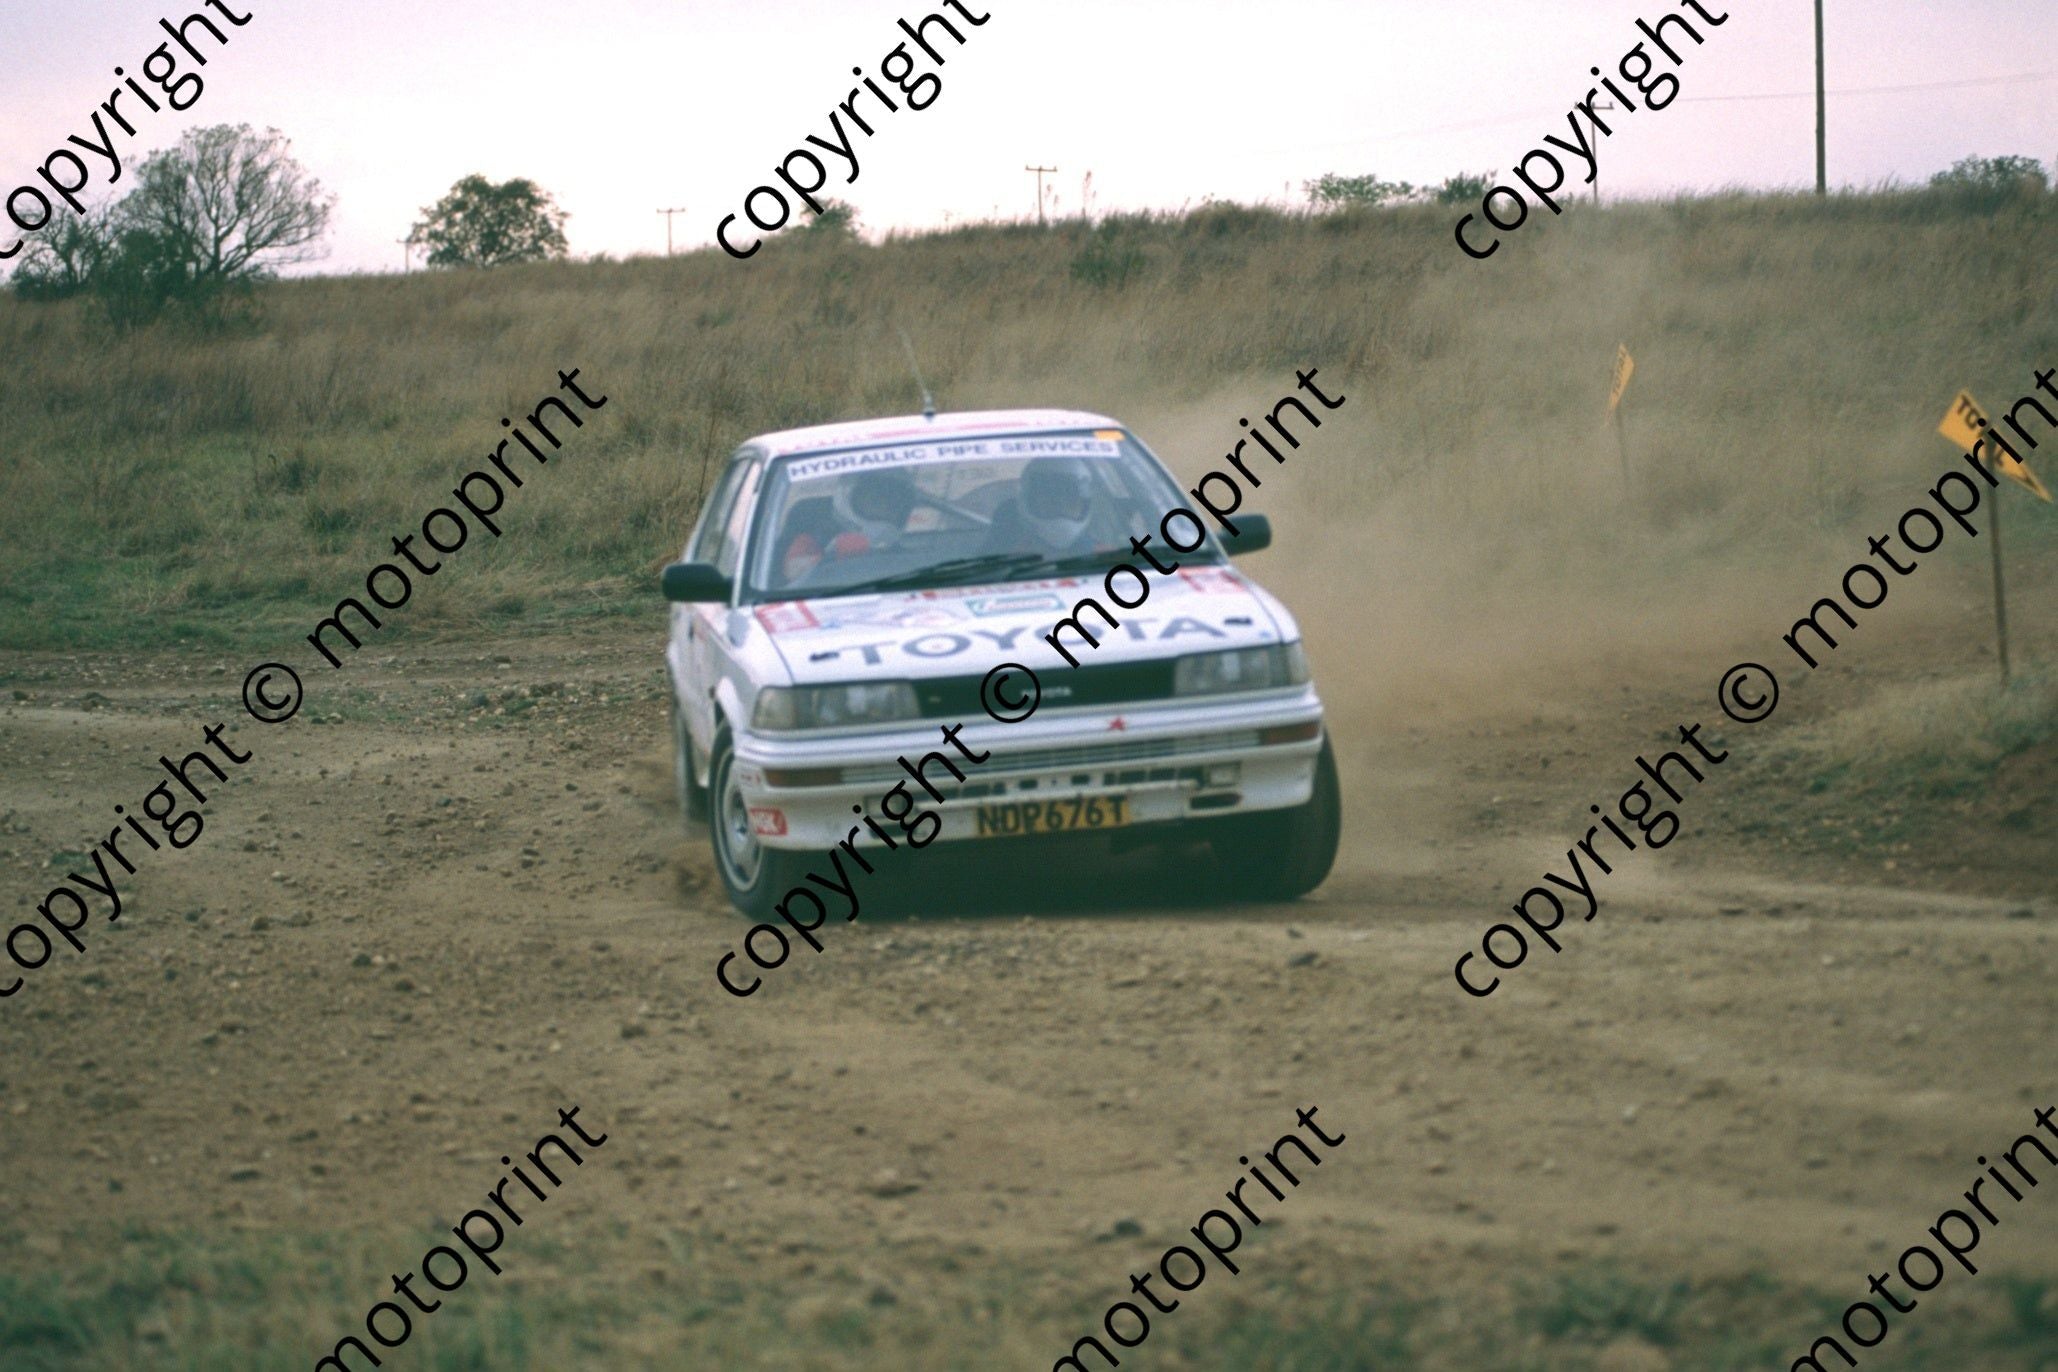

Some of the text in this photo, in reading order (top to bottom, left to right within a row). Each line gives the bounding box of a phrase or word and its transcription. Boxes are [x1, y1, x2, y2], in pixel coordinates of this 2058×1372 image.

[790, 438, 1115, 477] HYDRAULIC PIPE SERVICES
[838, 617, 1227, 666] TOYOTA
[977, 794, 1128, 835] NDP676T
